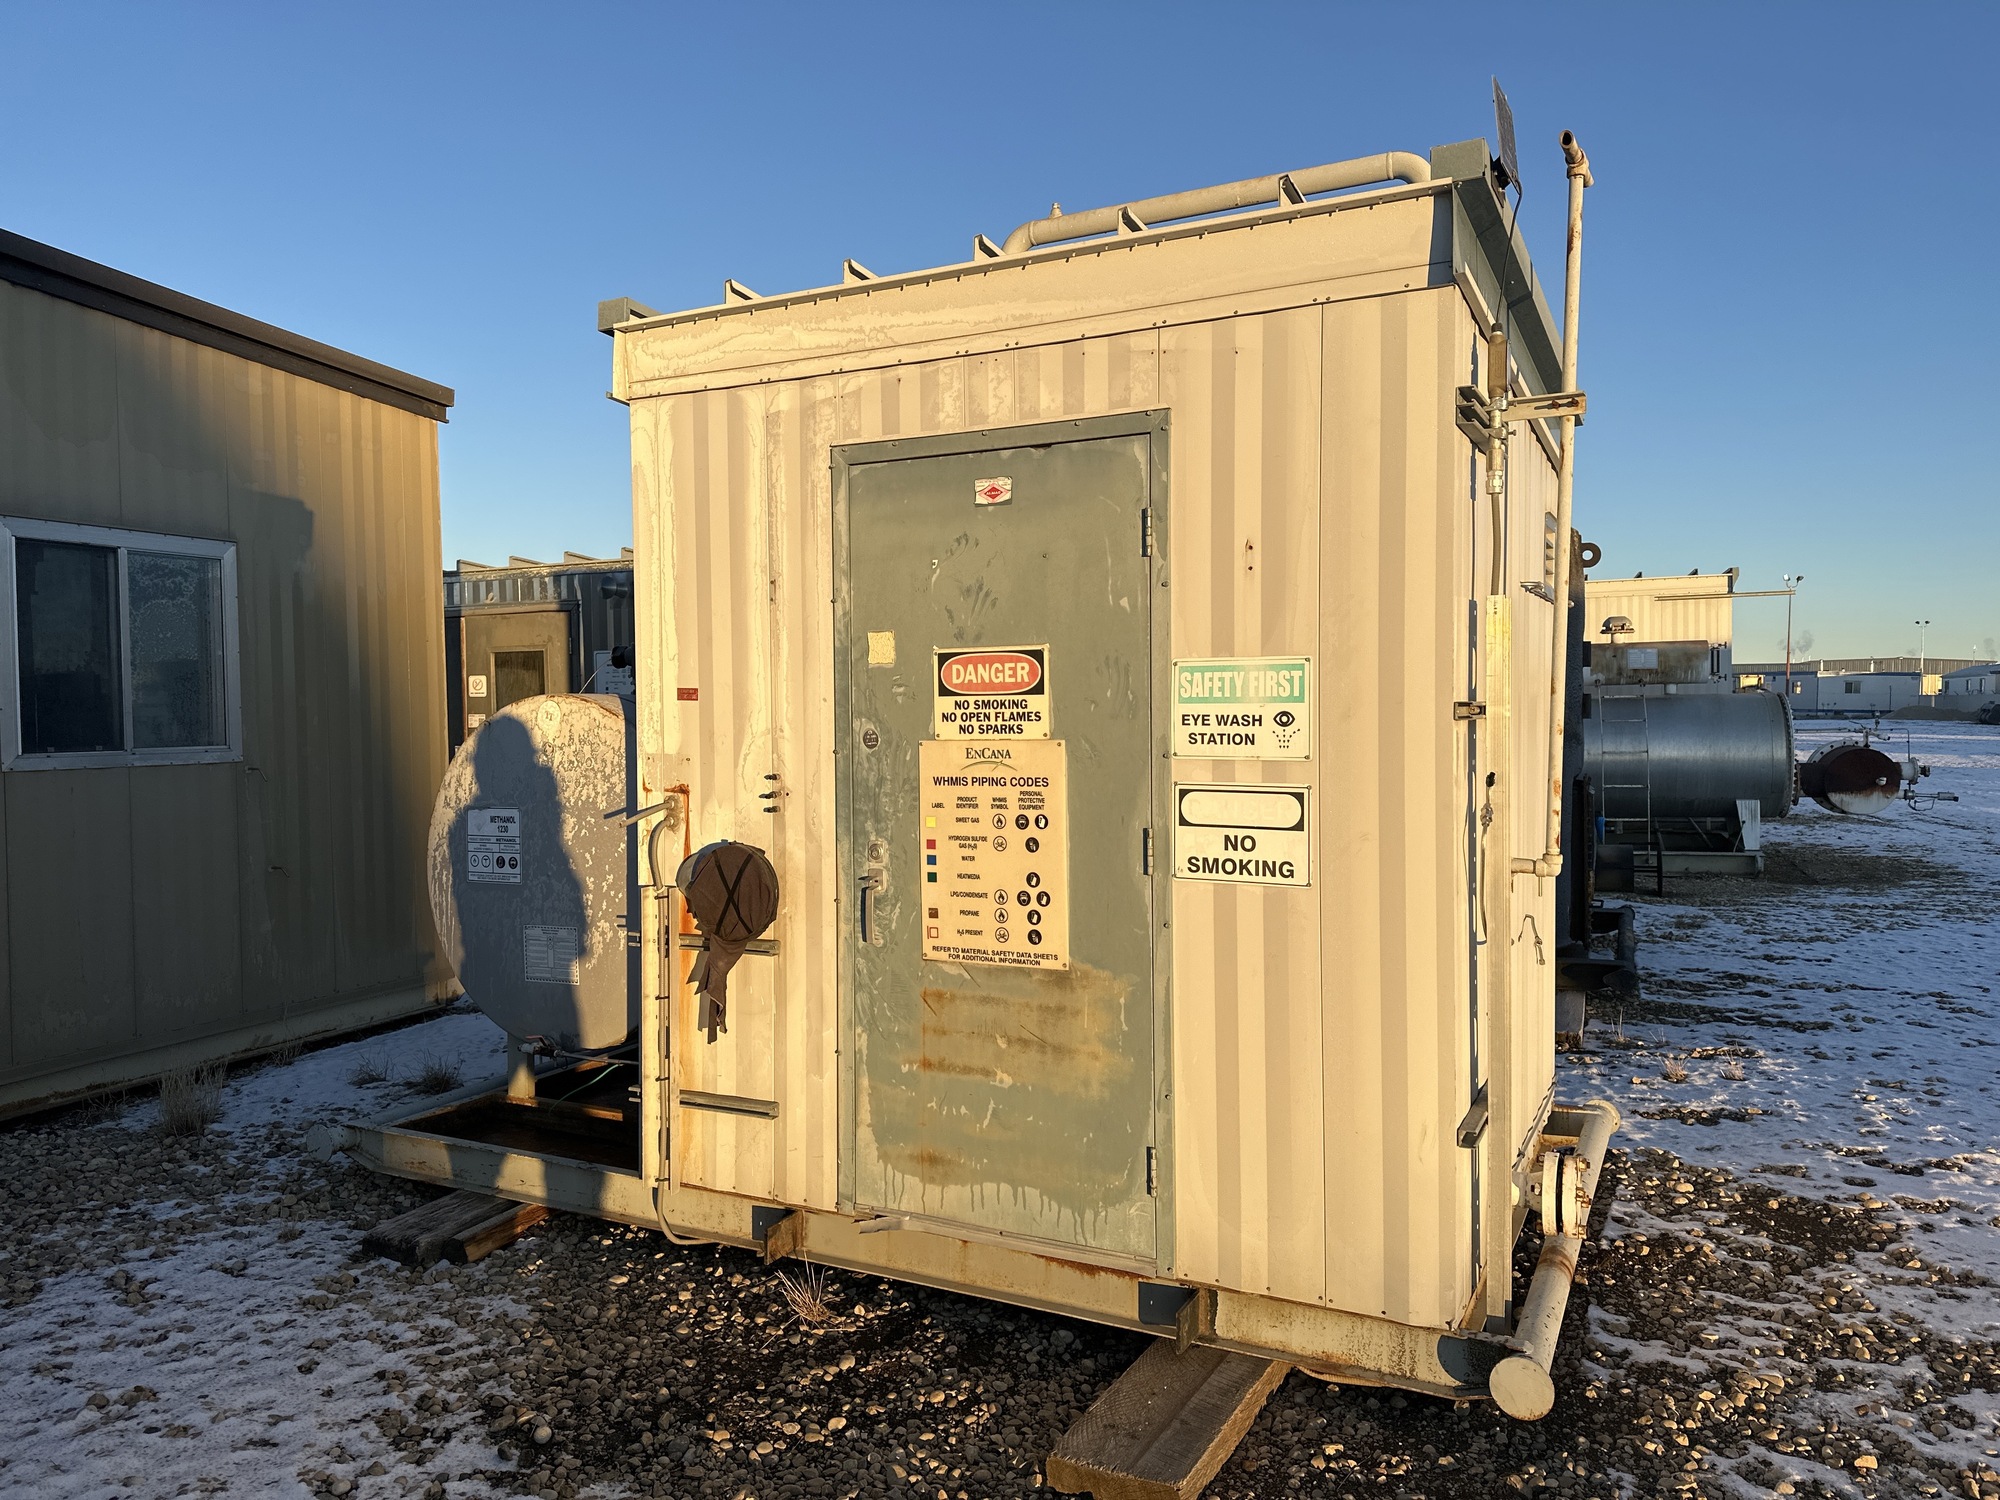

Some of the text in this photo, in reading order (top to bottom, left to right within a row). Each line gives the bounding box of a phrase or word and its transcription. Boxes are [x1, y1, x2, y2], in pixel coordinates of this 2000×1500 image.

[952, 662, 1030, 684] DANGER
[1180, 670, 1303, 698] SAFETY FIRST
[954, 699, 1028, 710] NO SMOKING
[942, 711, 1042, 723] NO OPEN FLAMES
[1181, 714, 1263, 727] EYE WASH
[959, 724, 1024, 735] NO SPARKS
[1188, 733, 1256, 746] STATION
[933, 776, 1049, 787] WHMIS PIPING CODES
[490, 815, 516, 824] METHANOL
[497, 825, 509, 833] 1230
[1224, 834, 1257, 852] NO
[1187, 856, 1295, 879] SMOKING
[956, 872, 981, 880] HEATMEDIA
[949, 890, 989, 899] LPG/CONDENSATE
[959, 909, 980, 917] PROPANE
[932, 945, 951, 953] REFER
[961, 948, 990, 956] MATERIAL
[991, 949, 1015, 957] SAFETY
[1016, 951, 1032, 959] DATA
[1033, 952, 1059, 961] SHEETS
[961, 954, 997, 963] ADDITIONAL
[998, 956, 1041, 966] INFORMATION
